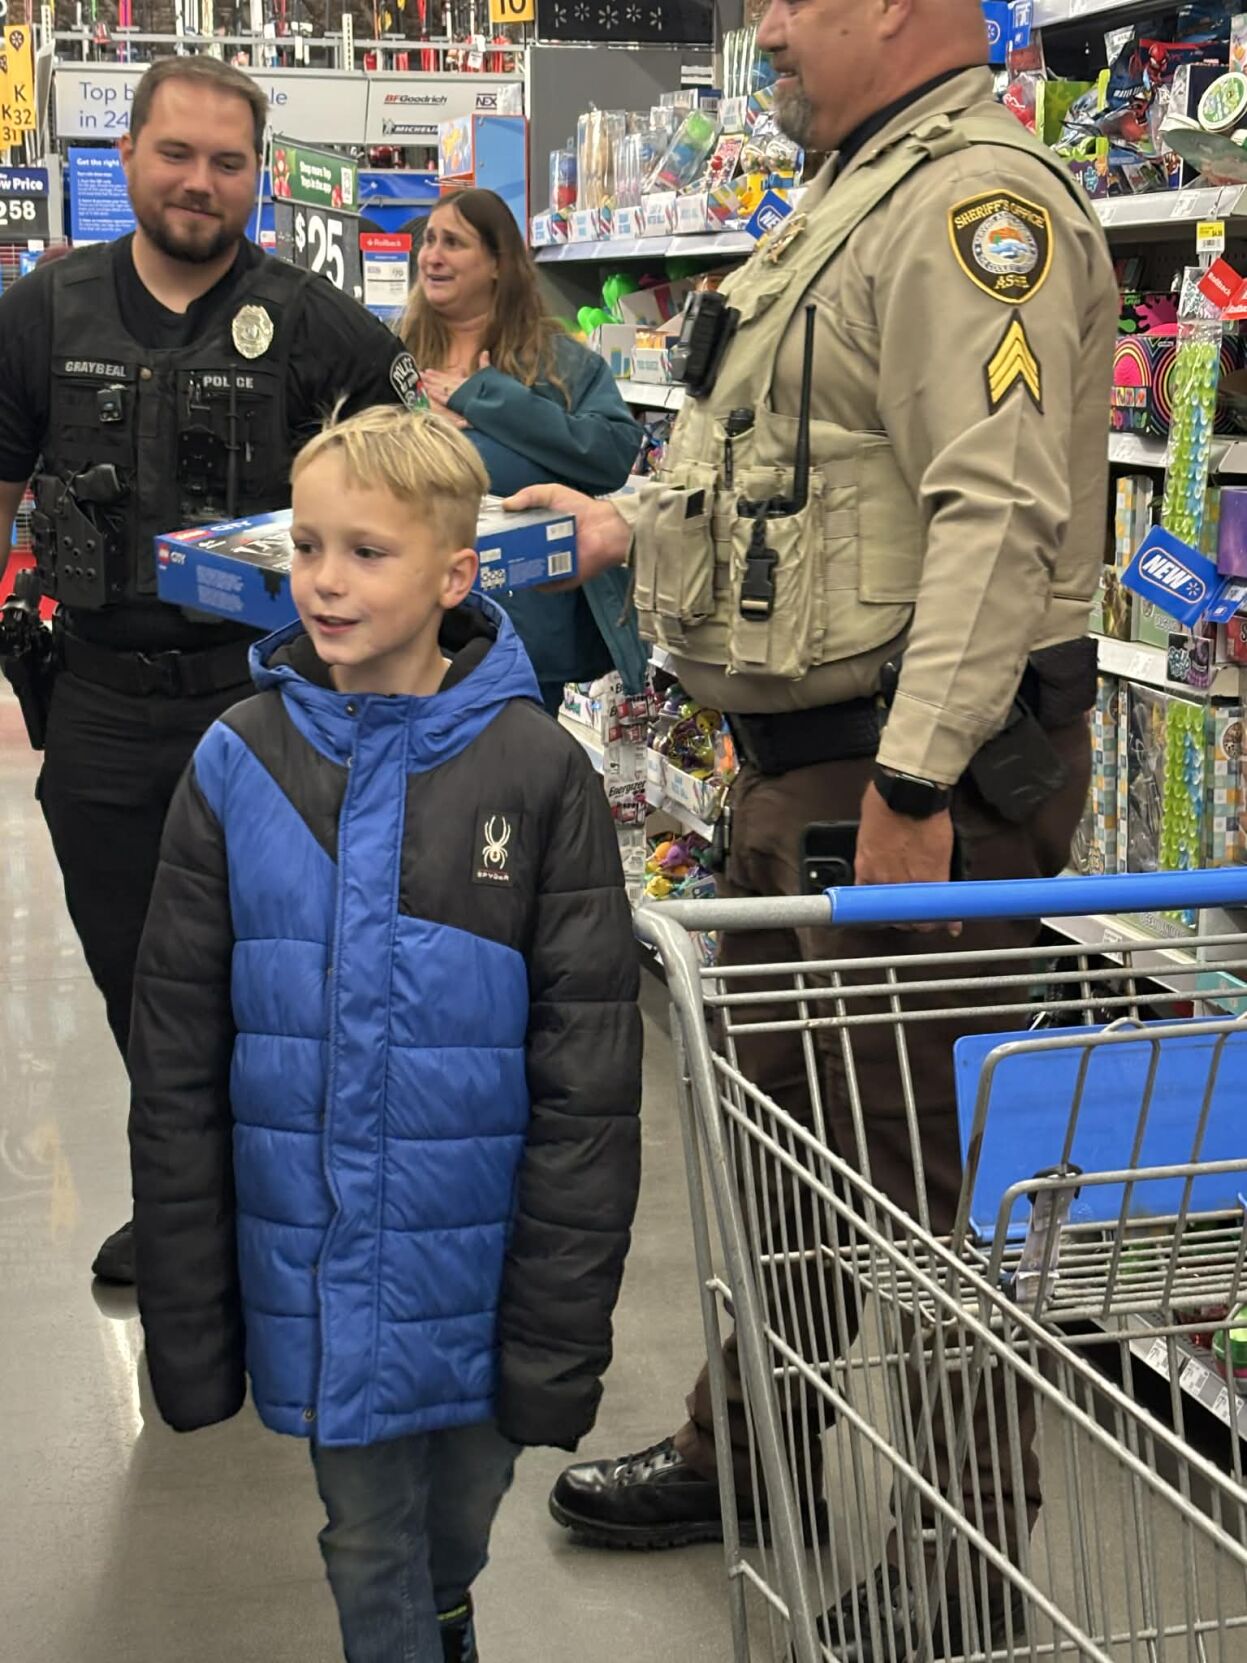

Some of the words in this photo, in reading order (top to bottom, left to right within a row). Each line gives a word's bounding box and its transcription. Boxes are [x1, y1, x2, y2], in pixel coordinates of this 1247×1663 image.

[14, 84, 27, 103] K
[79, 81, 117, 106] Top
[476, 96, 497, 107] NEX
[1, 103, 12, 121] K
[13, 109, 32, 126] 32
[80, 110, 97, 128] in
[3, 126, 17, 142] 31
[395, 125, 439, 134] MICHELI
[12, 177, 44, 191] Price
[760, 210, 781, 232] NE
[294, 211, 345, 291] $25
[65, 361, 127, 378] GRAYBEAL
[203, 376, 254, 389] POLCE
[1142, 554, 1193, 590] NEW
[609, 780, 647, 797] Energizer
